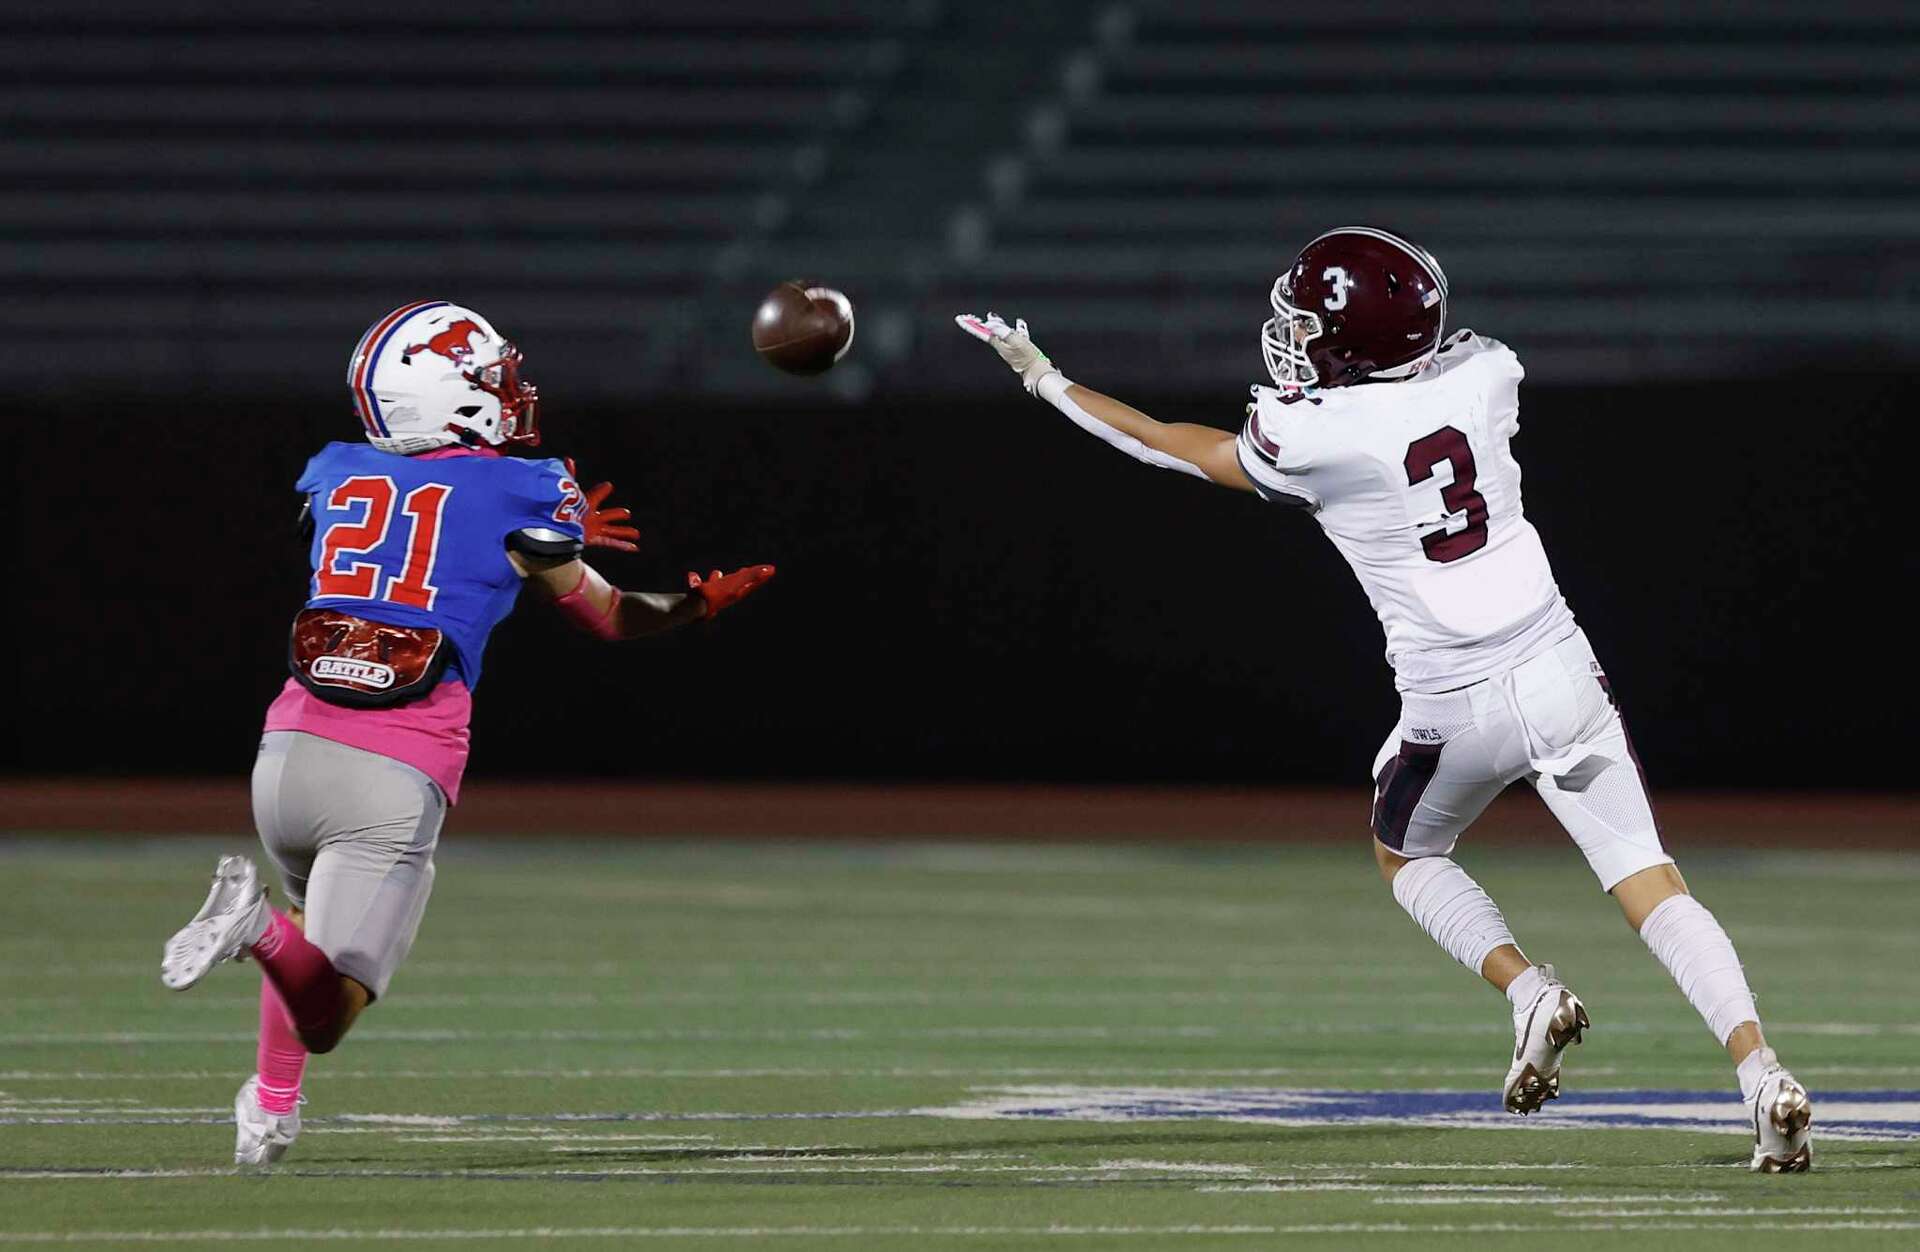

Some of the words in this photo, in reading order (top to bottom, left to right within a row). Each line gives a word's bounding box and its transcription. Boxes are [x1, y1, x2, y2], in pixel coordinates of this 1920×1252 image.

[1322, 266, 1347, 311] 3
[1404, 424, 1490, 564] 3
[313, 475, 453, 612] 21
[317, 660, 388, 684] BATTLE
[1411, 728, 1442, 741] OWLS
